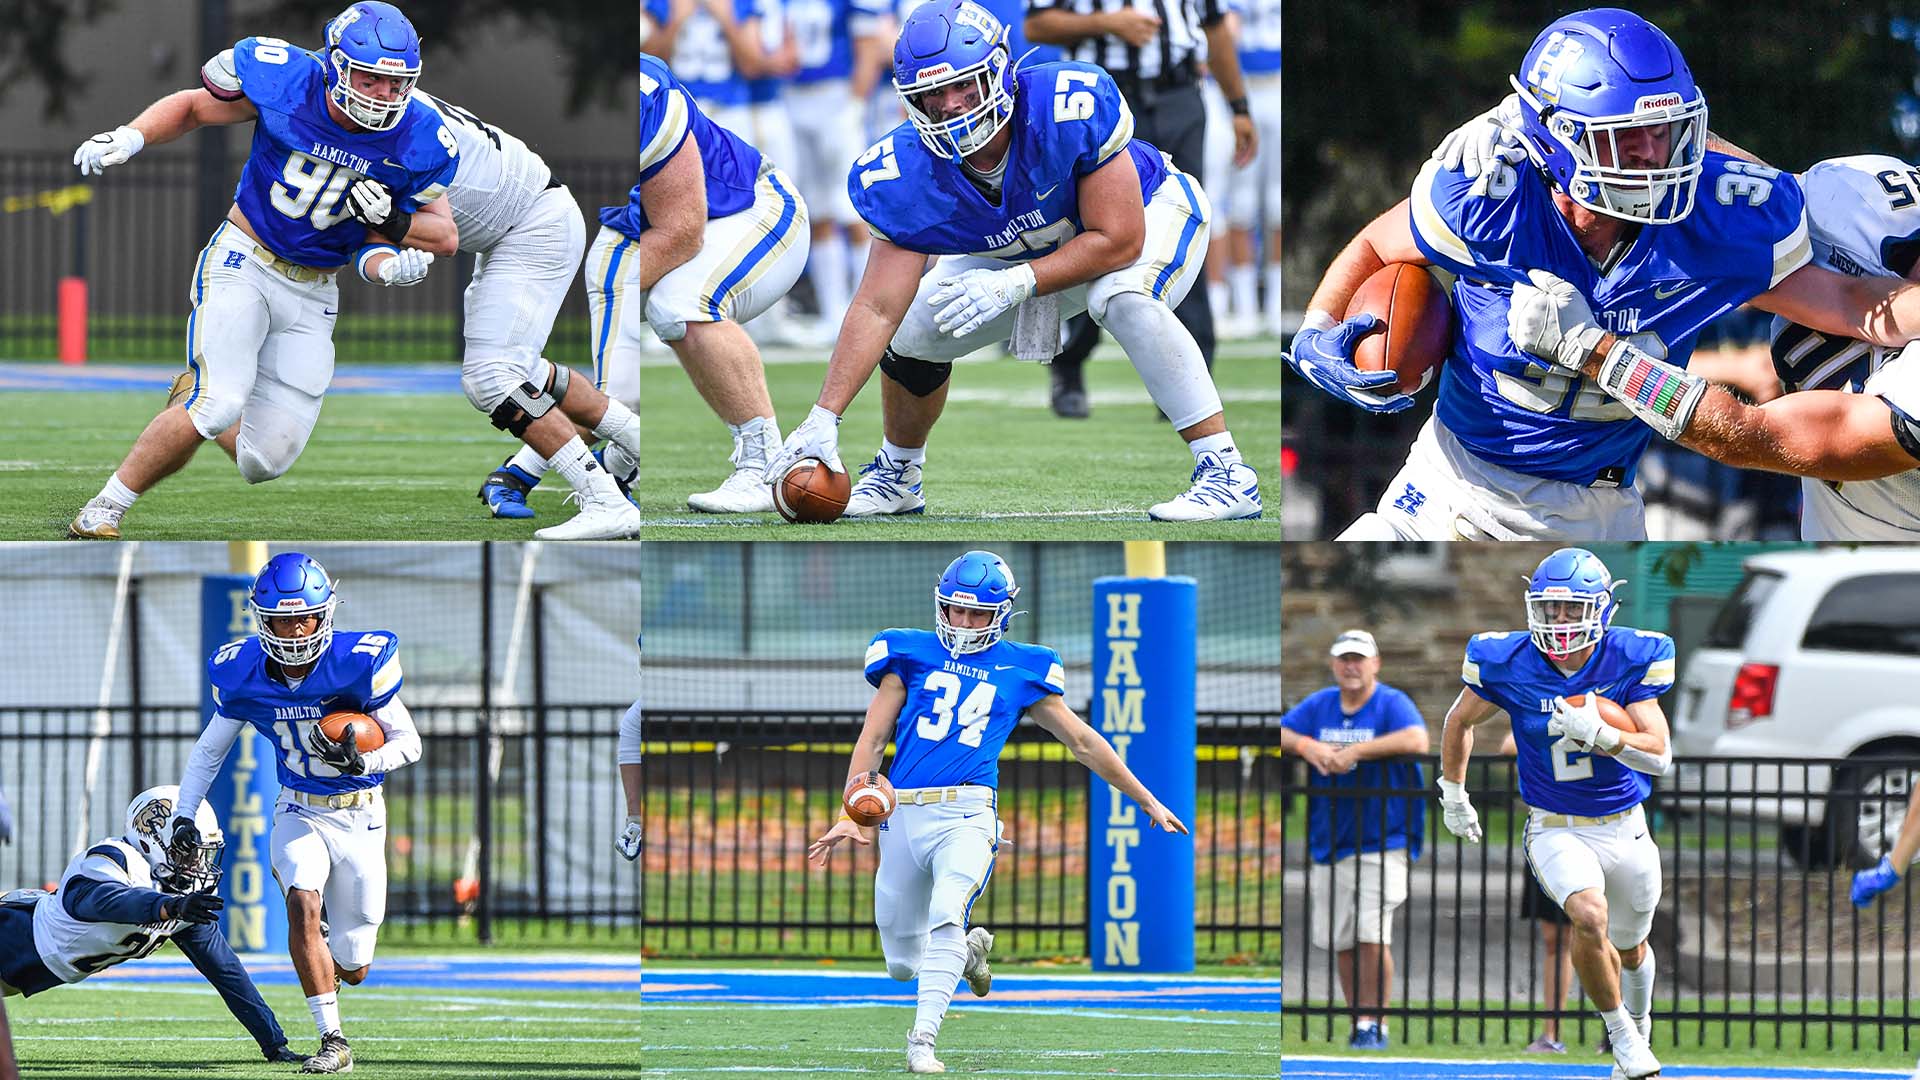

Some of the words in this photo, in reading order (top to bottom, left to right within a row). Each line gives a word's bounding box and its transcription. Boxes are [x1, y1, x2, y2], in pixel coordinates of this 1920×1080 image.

[1053, 69, 1099, 123] 57
[1642, 96, 1680, 110] Riddell
[311, 142, 372, 175] HAMILTON
[856, 134, 902, 191] 57
[269, 150, 366, 231] 90
[983, 208, 1047, 249] HAMILTON
[1606, 469, 1613, 479] L
[279, 600, 303, 608] Riddell
[351, 633, 390, 658] 15
[943, 660, 990, 682] HAMILTON
[273, 705, 323, 720] HAMILTON
[916, 670, 998, 748] 34
[1547, 718, 1594, 782] 2
